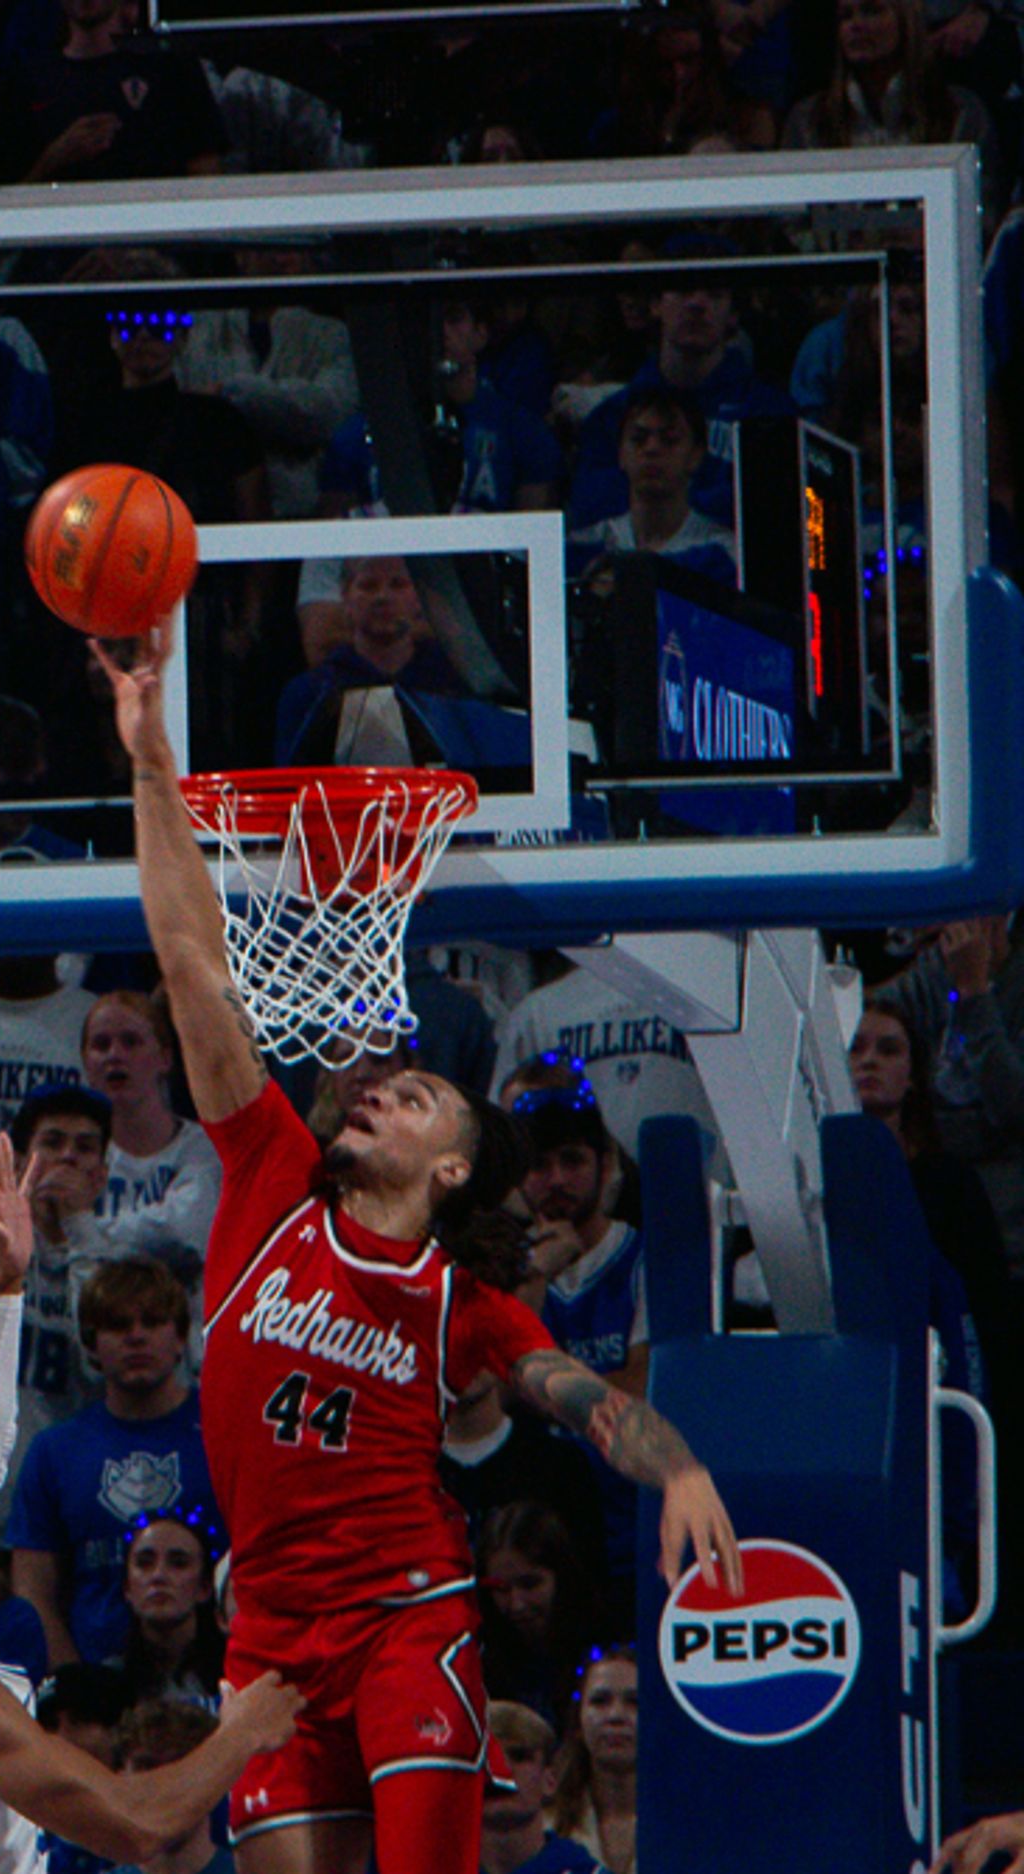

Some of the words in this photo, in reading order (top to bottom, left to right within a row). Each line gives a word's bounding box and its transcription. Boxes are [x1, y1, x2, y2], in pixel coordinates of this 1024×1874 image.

[238, 1266, 418, 1386] Redhawks
[262, 1369, 358, 1453] 44
[672, 1618, 845, 1663] PEPSI
